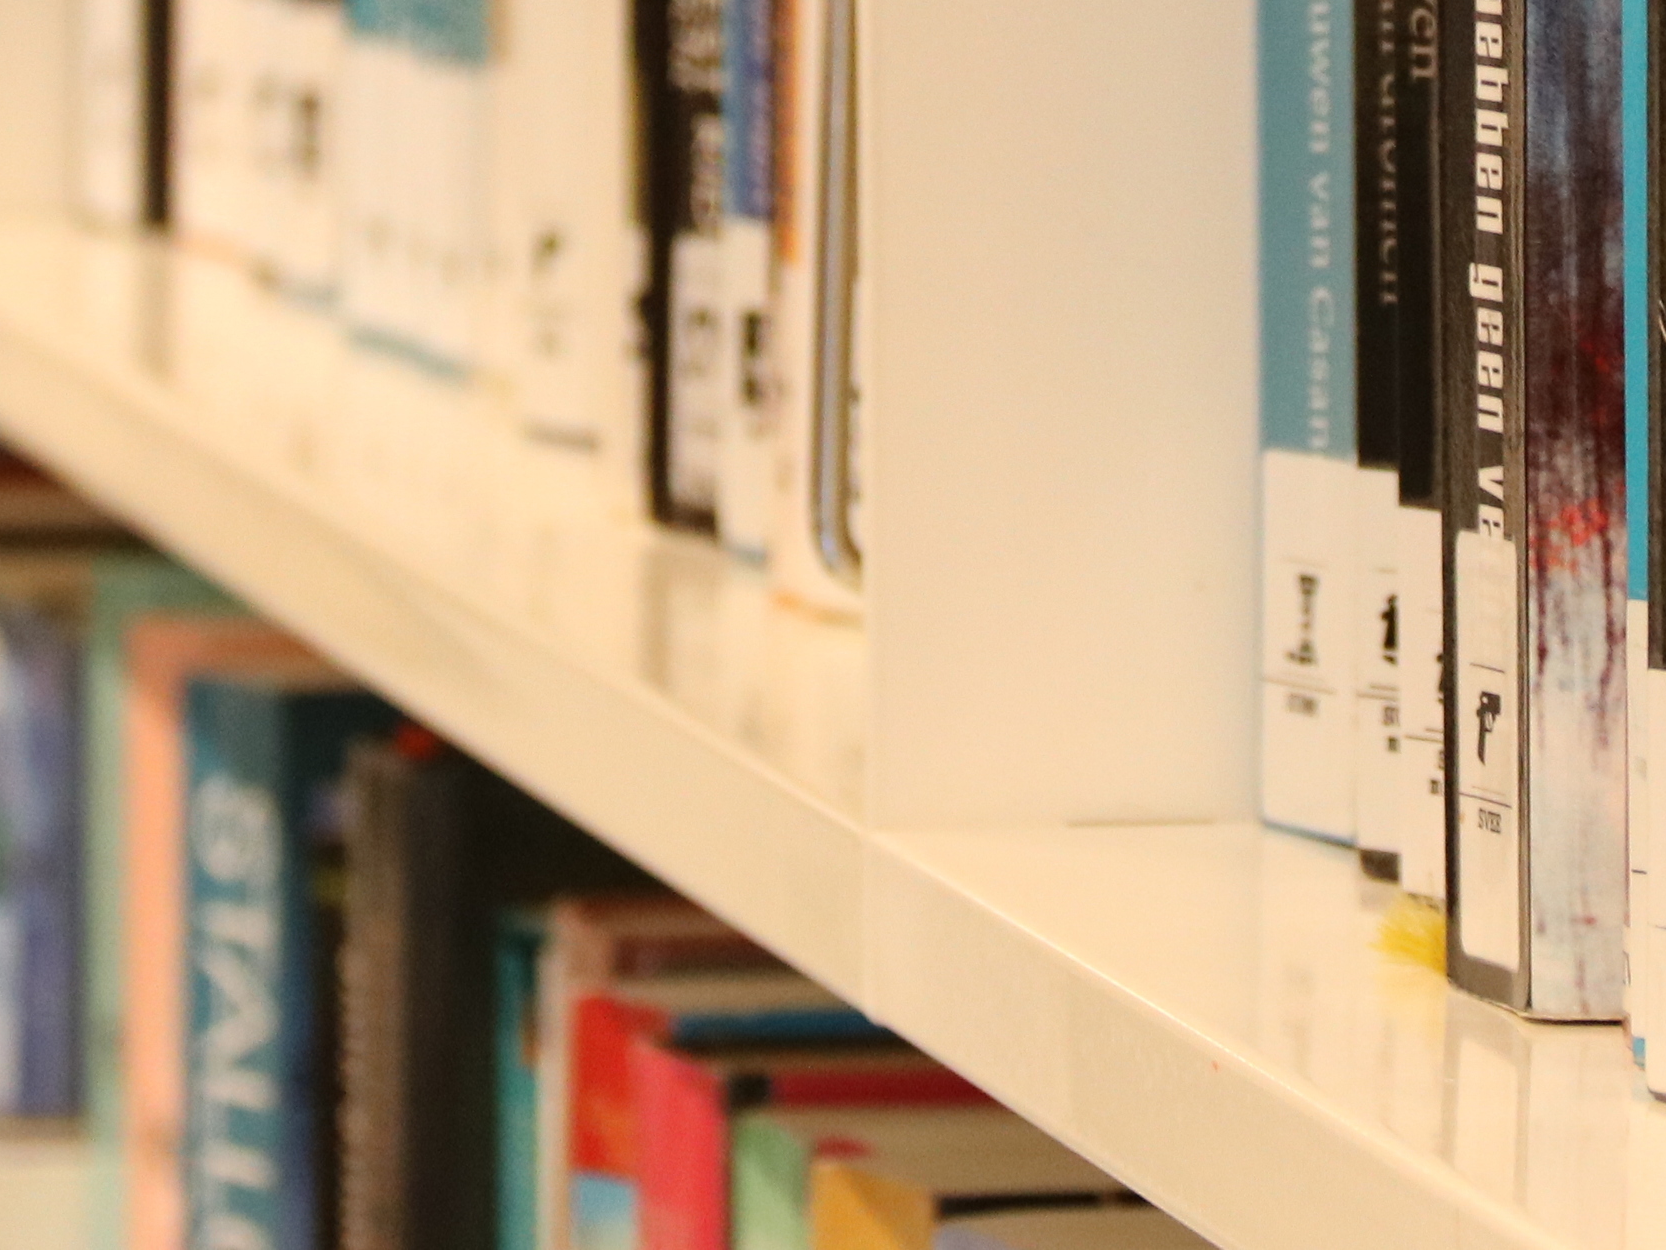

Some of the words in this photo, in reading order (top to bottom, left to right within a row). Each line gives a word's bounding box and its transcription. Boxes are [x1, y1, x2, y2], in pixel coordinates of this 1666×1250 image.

[1308, 170, 1331, 269] van
[1469, 261, 1505, 434] geen
[1477, 809, 1503, 836] SVEE
